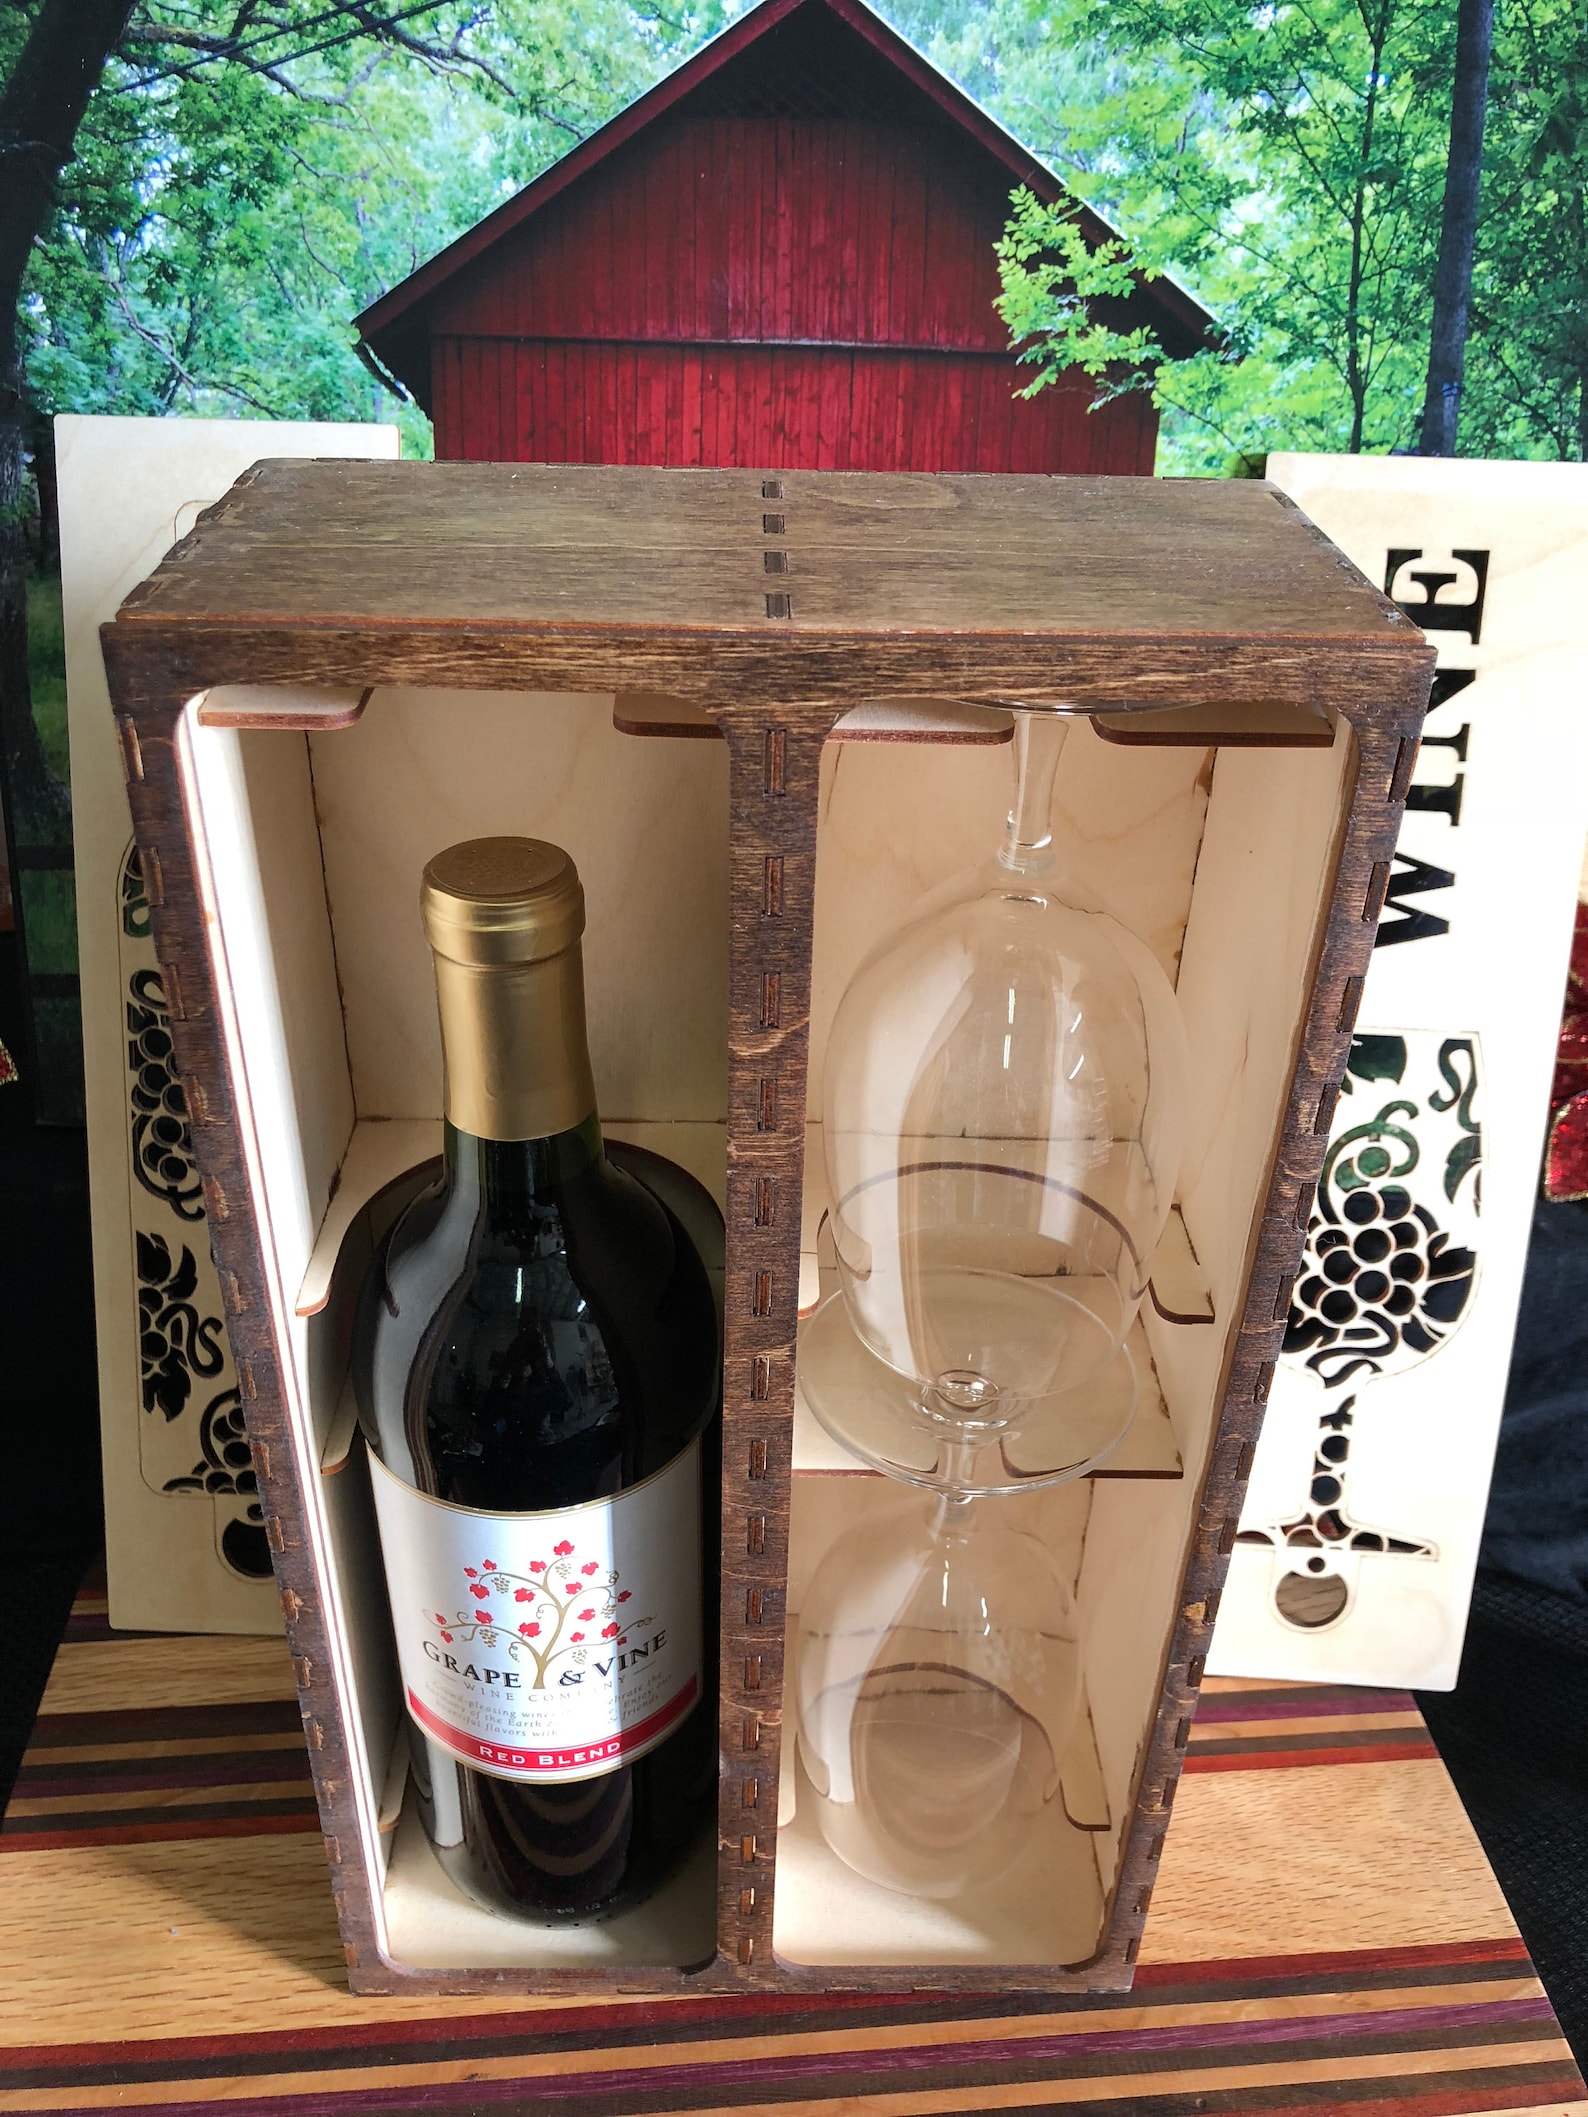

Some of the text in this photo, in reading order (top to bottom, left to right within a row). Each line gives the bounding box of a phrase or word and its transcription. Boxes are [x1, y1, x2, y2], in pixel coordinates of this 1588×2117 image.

[423, 1629, 667, 1689] GRAPE & VINE
[463, 1674, 625, 1702] WINE COMNY
[485, 1723, 526, 1737] flavors
[508, 1717, 542, 1728] Earth
[479, 1742, 621, 1766] RED BLEND
